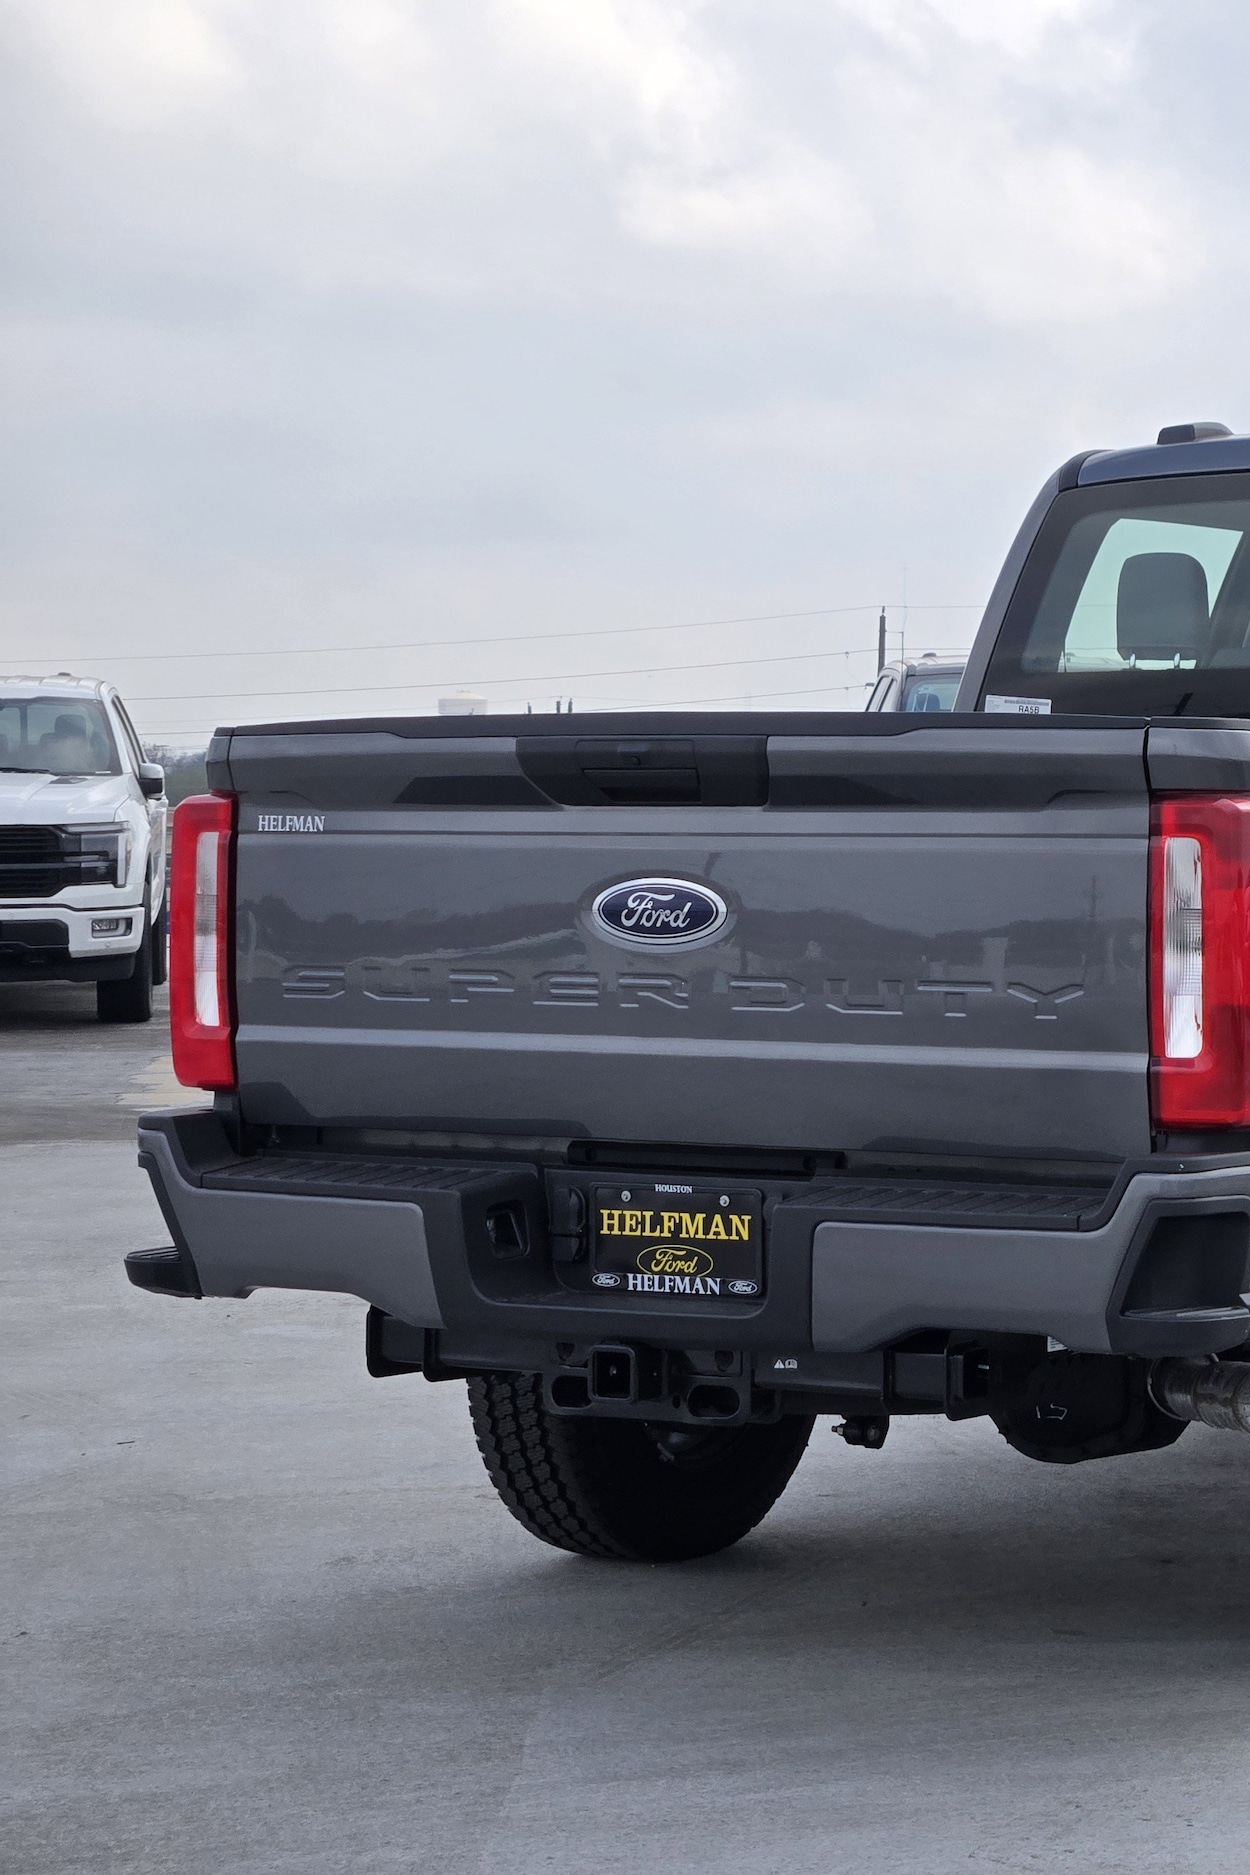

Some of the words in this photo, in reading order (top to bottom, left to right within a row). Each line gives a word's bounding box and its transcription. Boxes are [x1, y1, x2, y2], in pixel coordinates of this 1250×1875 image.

[257, 815, 325, 833] HELFMAN
[620, 891, 692, 928] Ford
[282, 965, 690, 1010] SUPER
[729, 976, 1085, 1020] DUTY
[654, 1184, 693, 1194] HOUSTON
[599, 1209, 752, 1241] HELFMAN
[651, 1248, 698, 1274] Ford
[627, 1273, 722, 1295] HELFMAN
